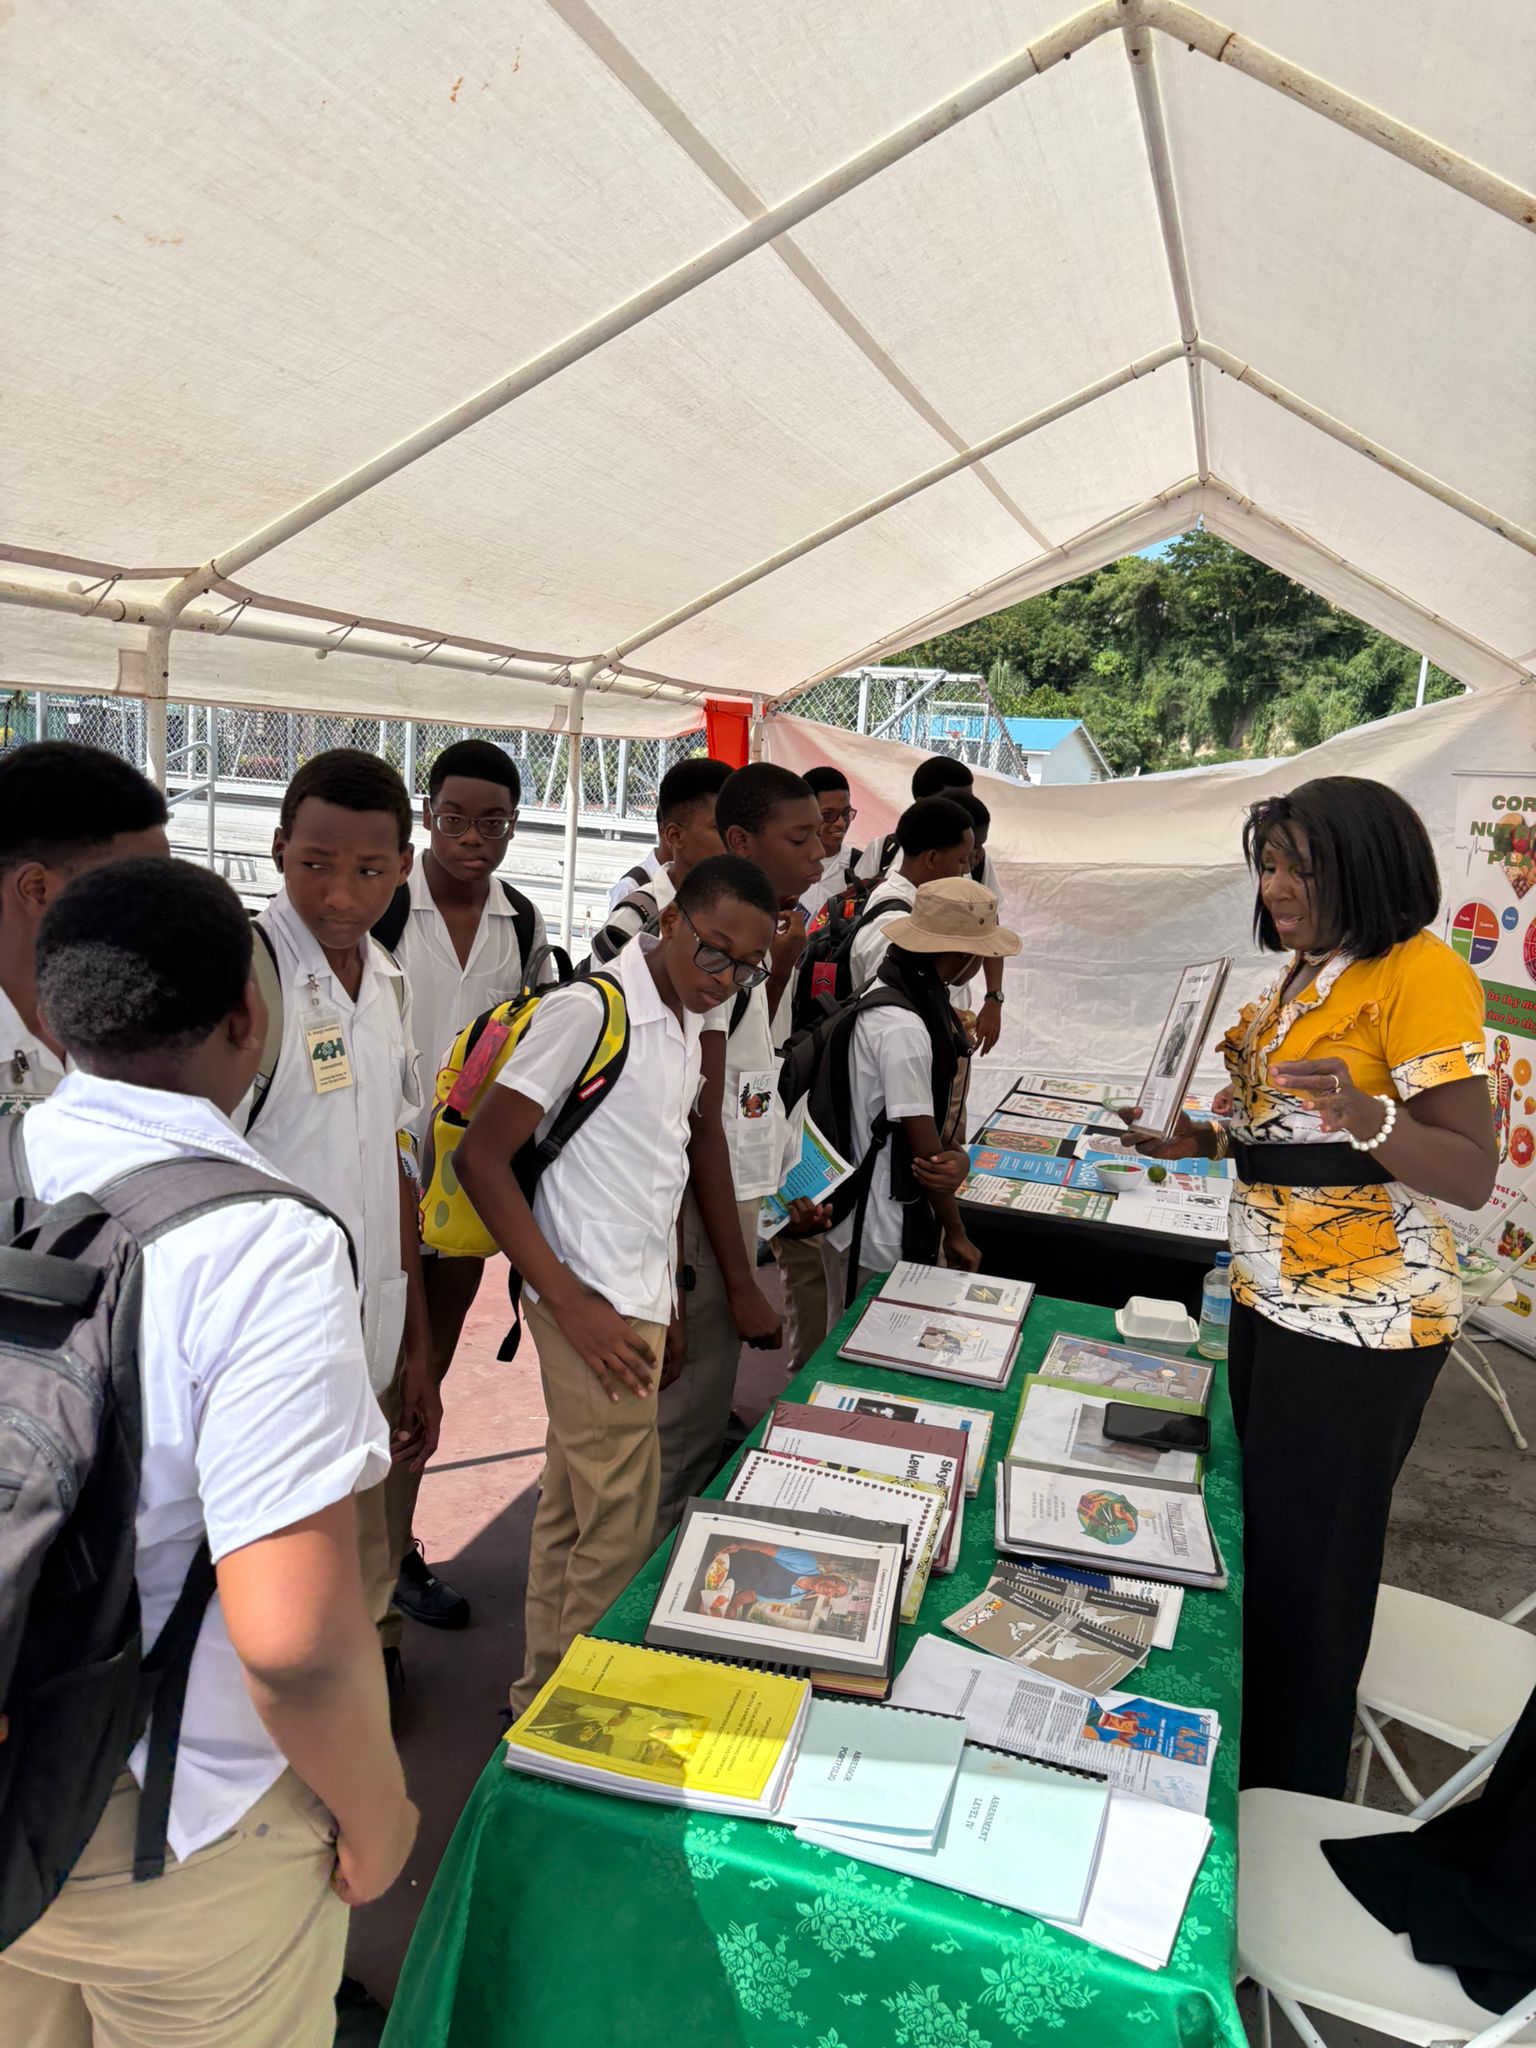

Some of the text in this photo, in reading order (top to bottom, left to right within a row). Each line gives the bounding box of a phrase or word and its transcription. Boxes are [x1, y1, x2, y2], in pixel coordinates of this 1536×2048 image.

[905, 1453, 924, 1479] Level
[827, 1745, 848, 1782] PORTFOLIO
[842, 1749, 862, 1782] ASSESSOR
[964, 1797, 982, 1830] LEVEL IV
[977, 1794, 1000, 1842] ASSESSMENT
